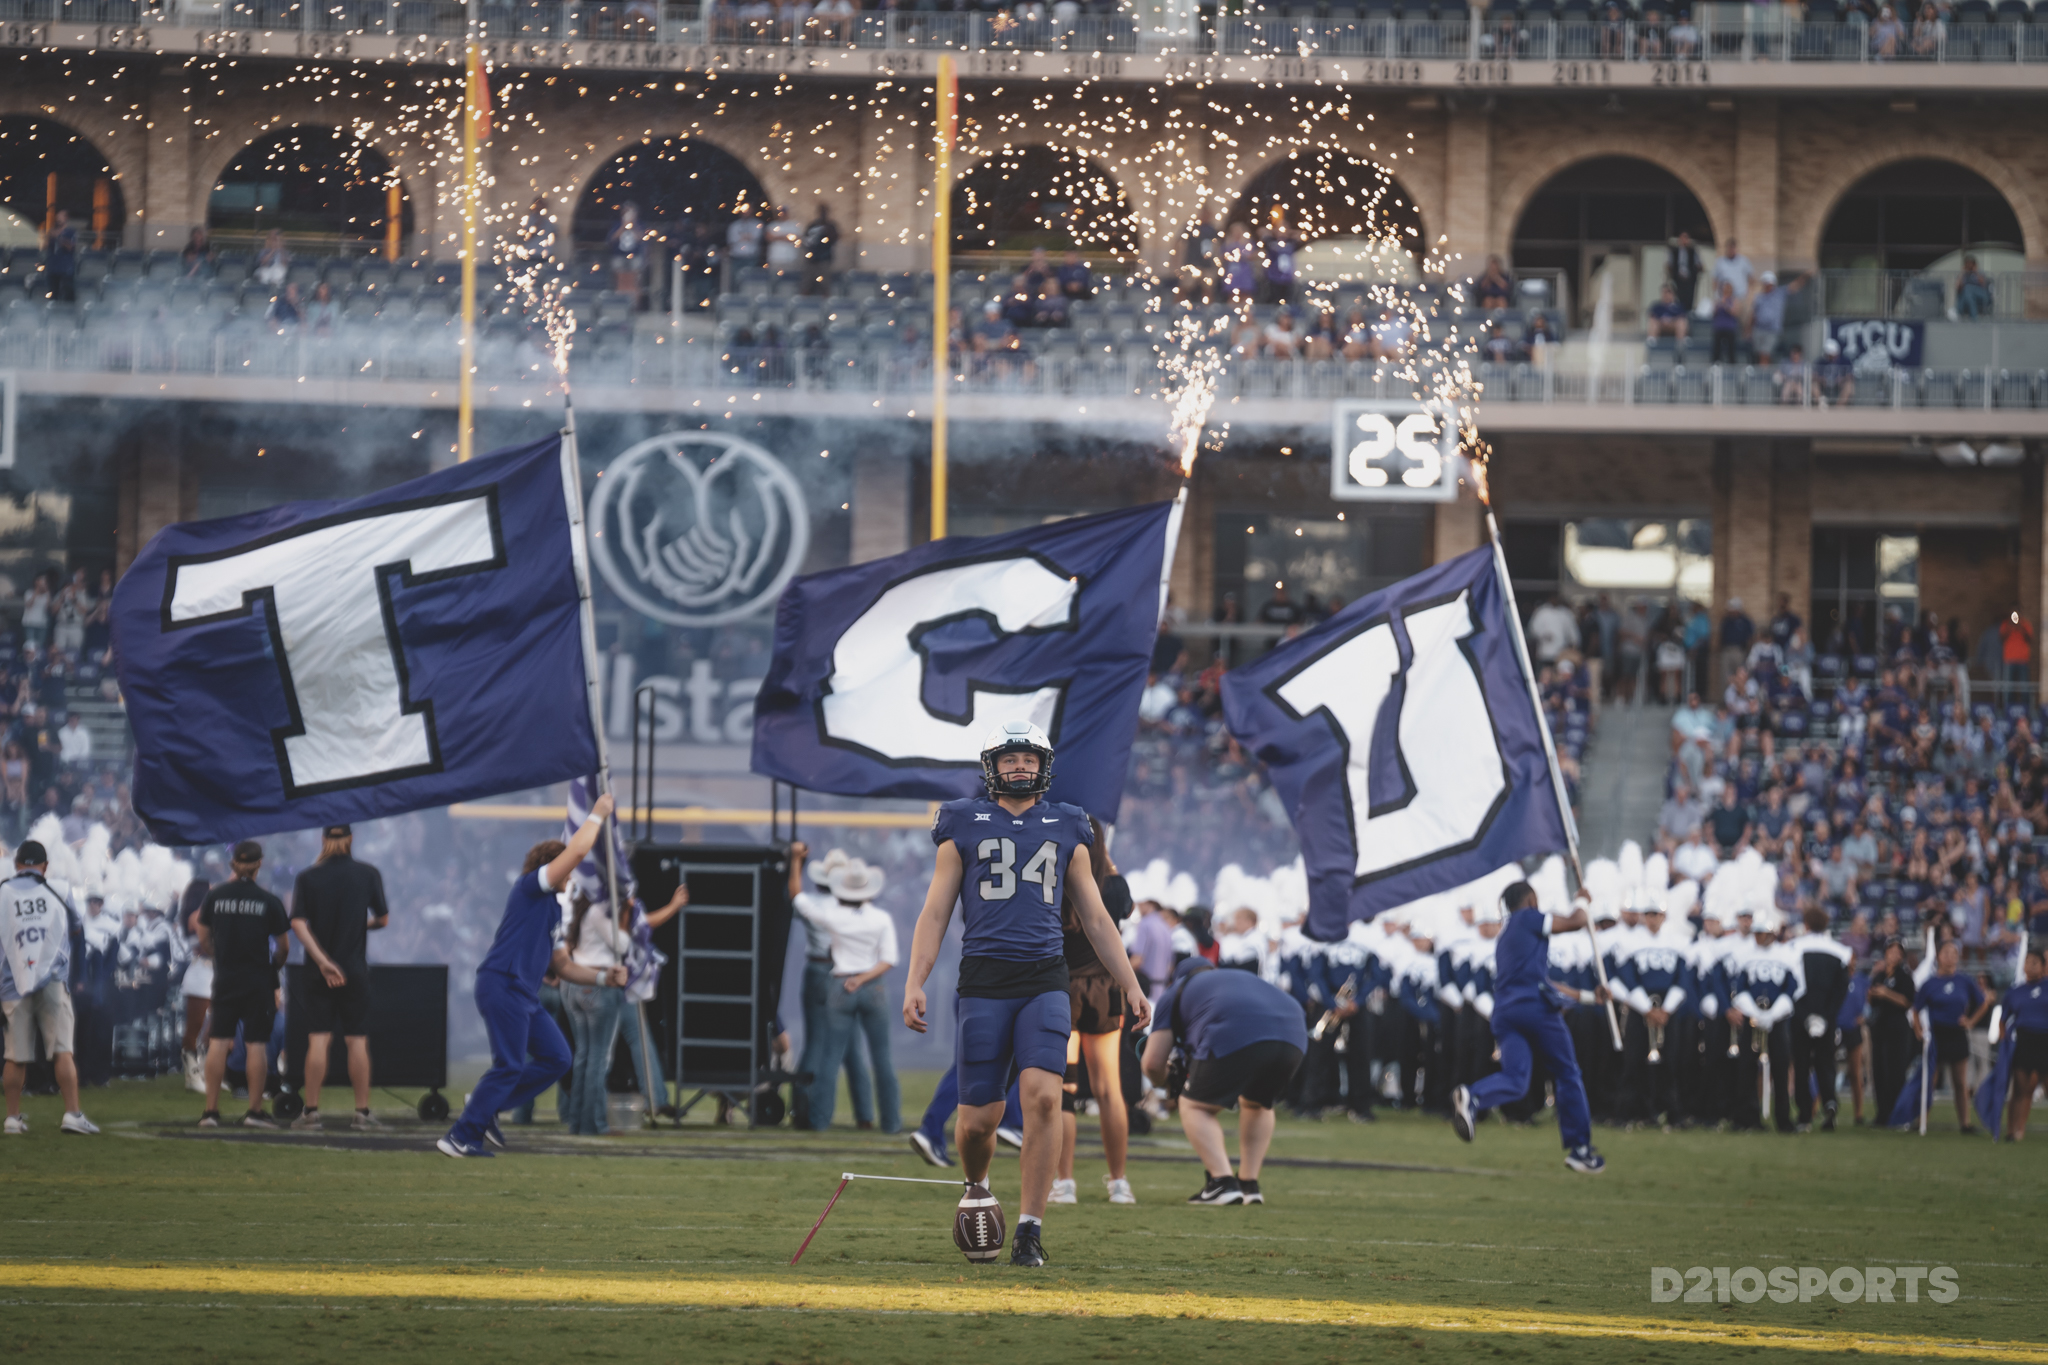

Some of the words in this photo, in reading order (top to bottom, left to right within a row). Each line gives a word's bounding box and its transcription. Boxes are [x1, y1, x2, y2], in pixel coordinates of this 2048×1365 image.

[2, 22, 49, 46] 951
[1363, 60, 1422, 84] 2009
[1454, 60, 1511, 84] 2010
[1552, 61, 1612, 85] 2011
[1651, 61, 1711, 86] 2014
[1837, 319, 1914, 358] TCU
[1349, 413, 1442, 488] 25
[161, 481, 507, 799] T
[814, 548, 1085, 769] C
[977, 837, 1059, 905] 34
[14, 897, 47, 918] 138
[213, 898, 237, 914] PYRO
[238, 898, 265, 916] CREW
